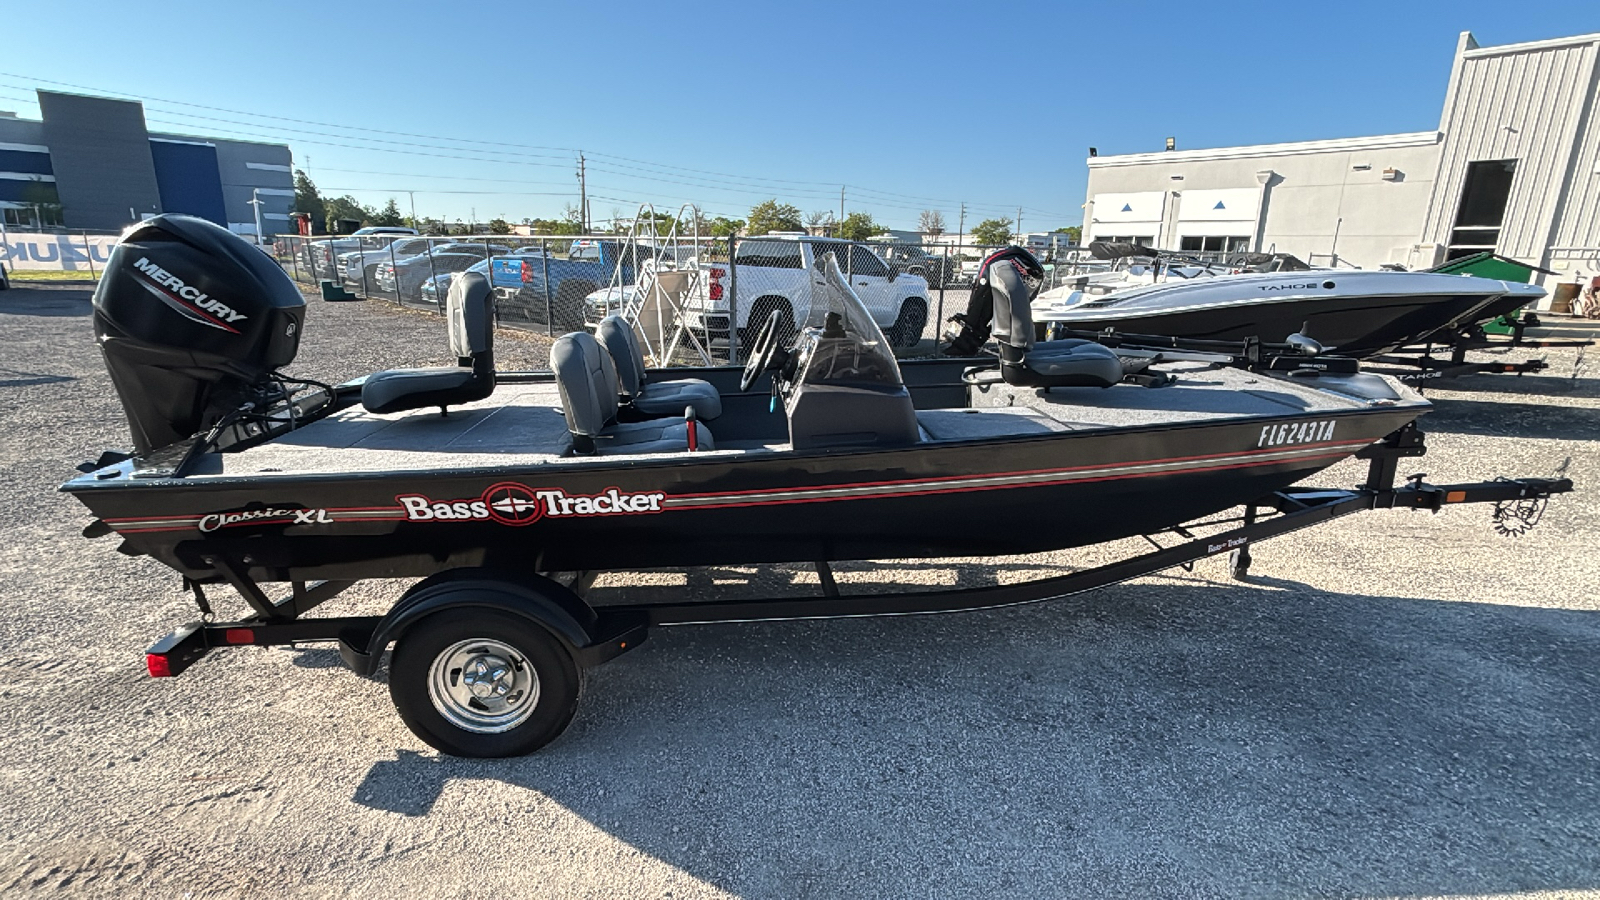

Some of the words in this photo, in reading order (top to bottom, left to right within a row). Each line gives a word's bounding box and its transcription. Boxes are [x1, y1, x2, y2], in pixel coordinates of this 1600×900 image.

[133, 257, 248, 323] MERCURY
[1258, 283, 1318, 291] TAHOE
[1396, 371, 1443, 381] TAHOE
[1257, 420, 1336, 447] FL6243TA
[399, 496, 490, 520] Bass
[536, 489, 664, 516] Tracker
[198, 508, 293, 532] Classic
[293, 509, 334, 524] XL
